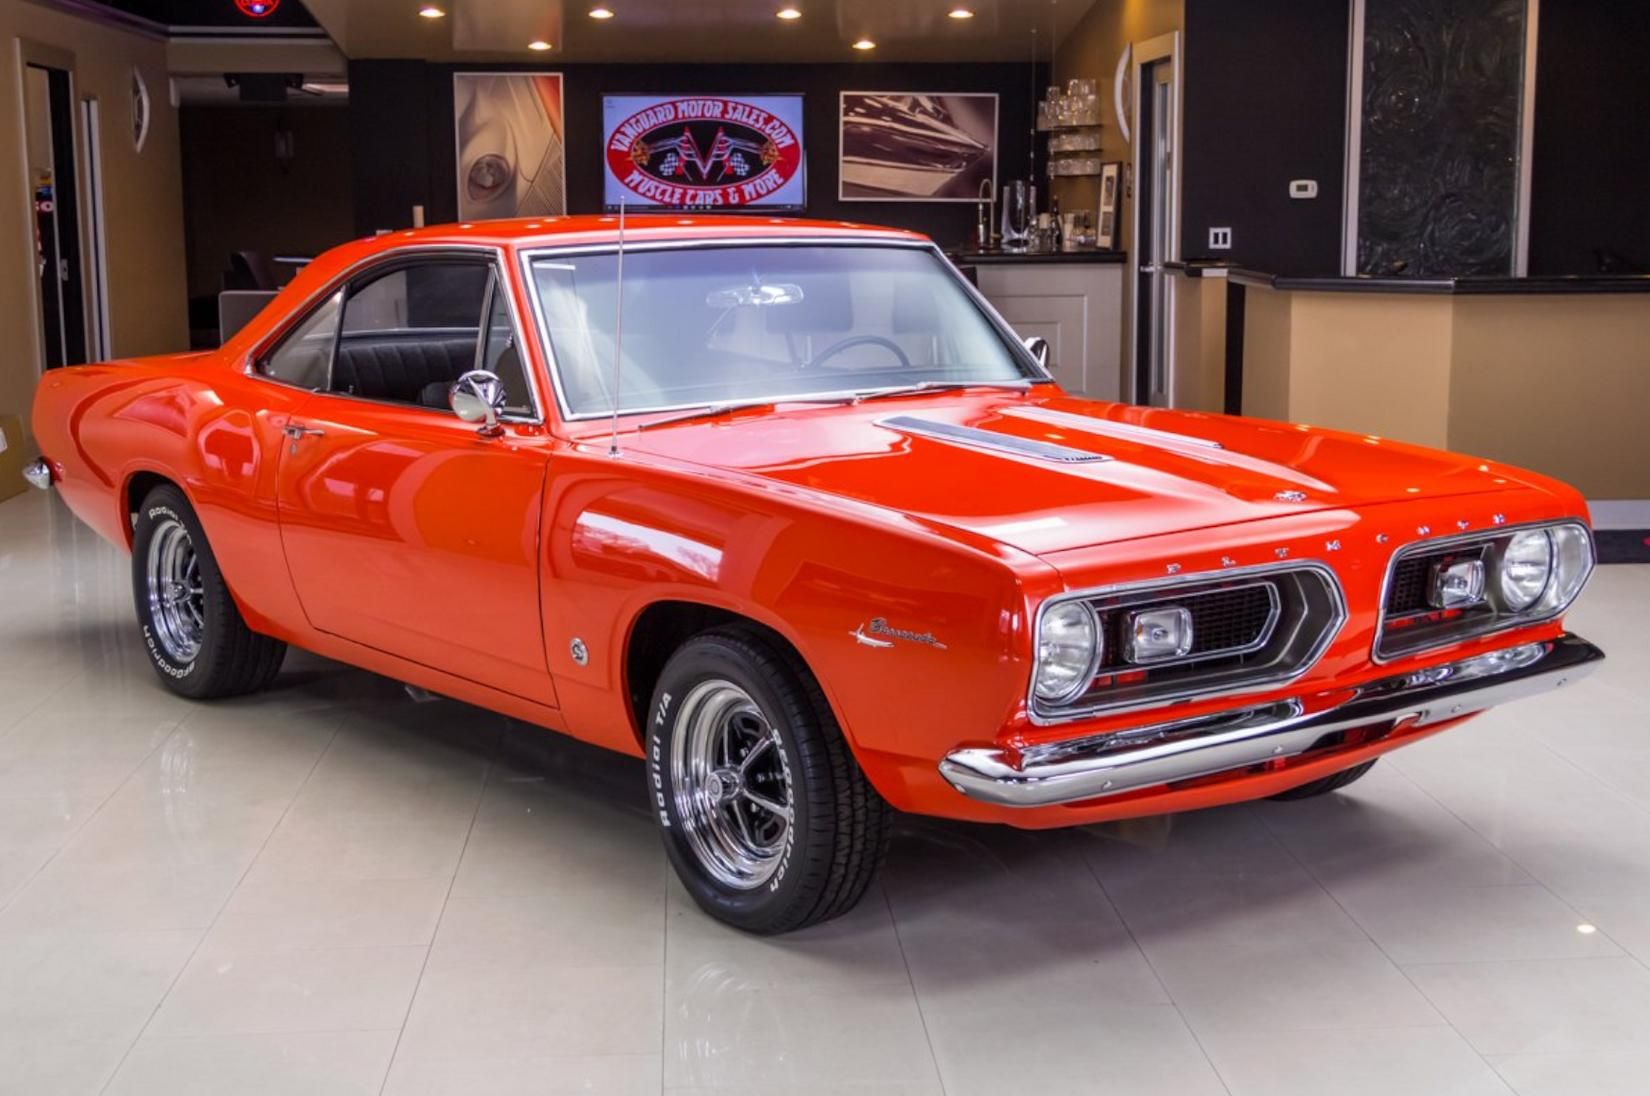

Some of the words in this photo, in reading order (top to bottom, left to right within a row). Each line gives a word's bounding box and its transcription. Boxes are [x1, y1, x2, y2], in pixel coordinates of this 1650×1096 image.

[610, 103, 675, 152] VANGUARD
[676, 100, 723, 119] MOTOR
[724, 101, 795, 149] SALES.COM
[624, 169, 684, 204] MUSCLE
[685, 190, 724, 205] CARS
[741, 168, 784, 201] MORE
[656, 692, 673, 727] T/A
